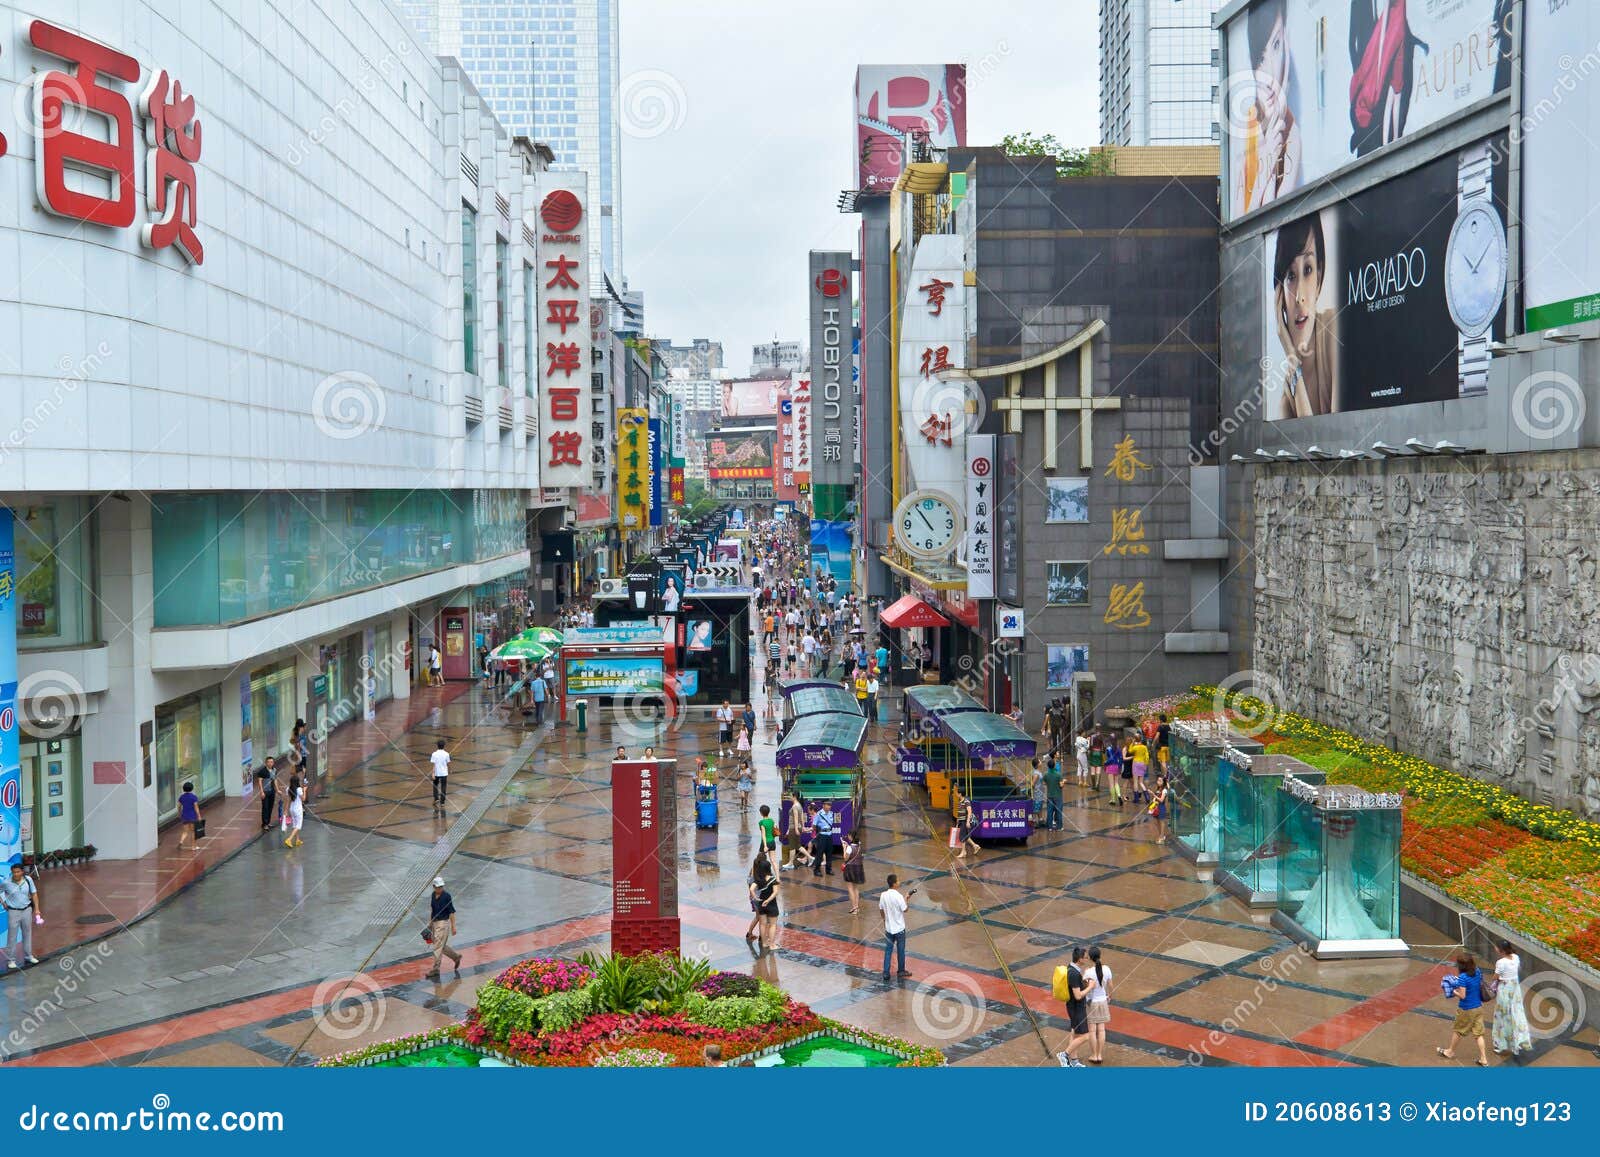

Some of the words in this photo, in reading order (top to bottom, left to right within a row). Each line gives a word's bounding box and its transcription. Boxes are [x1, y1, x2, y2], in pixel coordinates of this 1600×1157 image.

[29, 20, 204, 266] 百货
[542, 234, 581, 244] PACIFIC
[1348, 247, 1426, 306] MOVADO
[1367, 302, 1376, 312] THE
[1388, 295, 1405, 306] DESIGN
[544, 254, 583, 468] 太平洋百货
[823, 427, 841, 462] 高邦
[904, 519, 912, 530] 9
[945, 519, 953, 530] 3
[1103, 434, 1154, 630] 春熙路
[925, 538, 933, 550] 6
